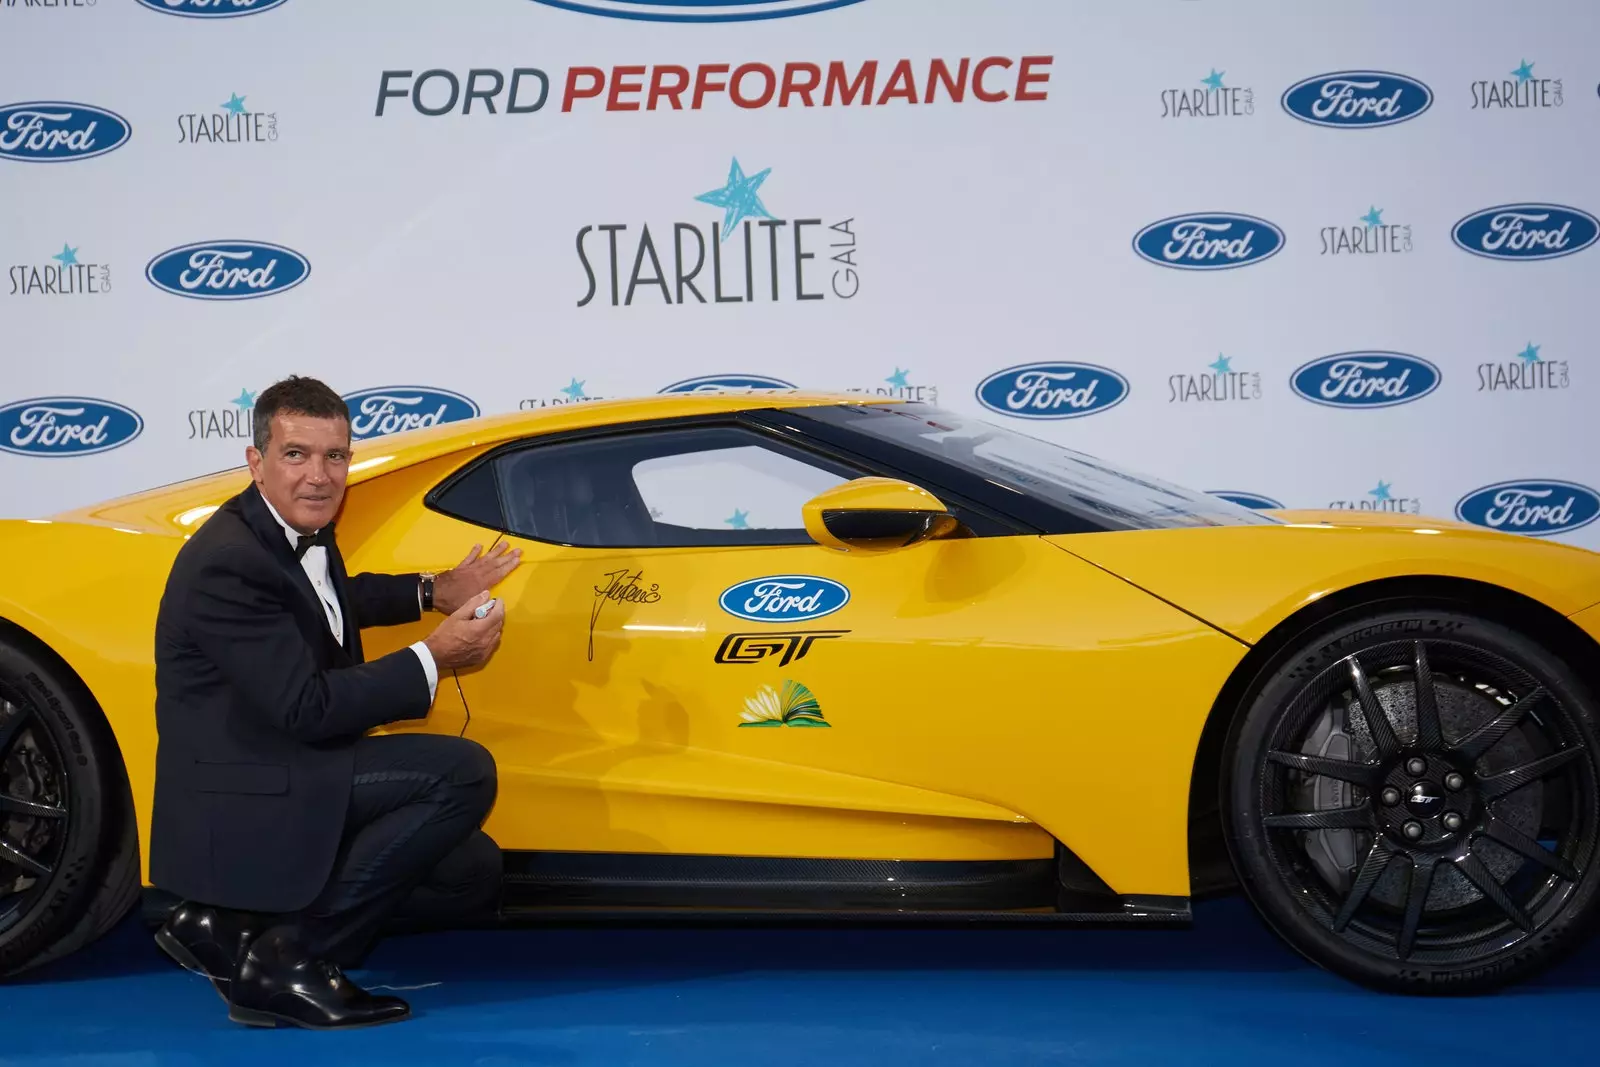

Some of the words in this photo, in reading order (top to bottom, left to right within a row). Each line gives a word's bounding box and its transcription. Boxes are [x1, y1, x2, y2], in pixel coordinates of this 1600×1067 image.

[375, 68, 549, 117] FORD
[561, 55, 1054, 112] PERFORMANCE
[1161, 86, 1242, 118] STARLITE
[1312, 79, 1402, 118] Ford
[1472, 78, 1551, 109] STARLITE
[0, 111, 97, 151] Ford
[178, 112, 265, 143] STARLITE
[267, 112, 278, 141] GALA
[1164, 222, 1253, 260] Ford
[1321, 225, 1401, 255] STARLITE
[1482, 213, 1571, 250] Ford
[180, 250, 276, 289] Ford
[576, 218, 824, 307] STARLITE
[828, 217, 859, 299] GALA
[10, 262, 98, 295] STARLITE
[100, 263, 112, 293] GALA
[1007, 372, 1098, 409] Ford
[1169, 371, 1249, 402] STARLITE
[1321, 361, 1410, 398] Ford
[1478, 360, 1556, 391] STARLITE
[11, 407, 109, 446] Ford
[188, 409, 252, 440] STARLI
[351, 396, 447, 435] Ford
[1485, 489, 1576, 527] Ford
[744, 582, 824, 613] Ford
[713, 629, 852, 667] GT
[1340, 619, 1421, 647] MICHELIN
